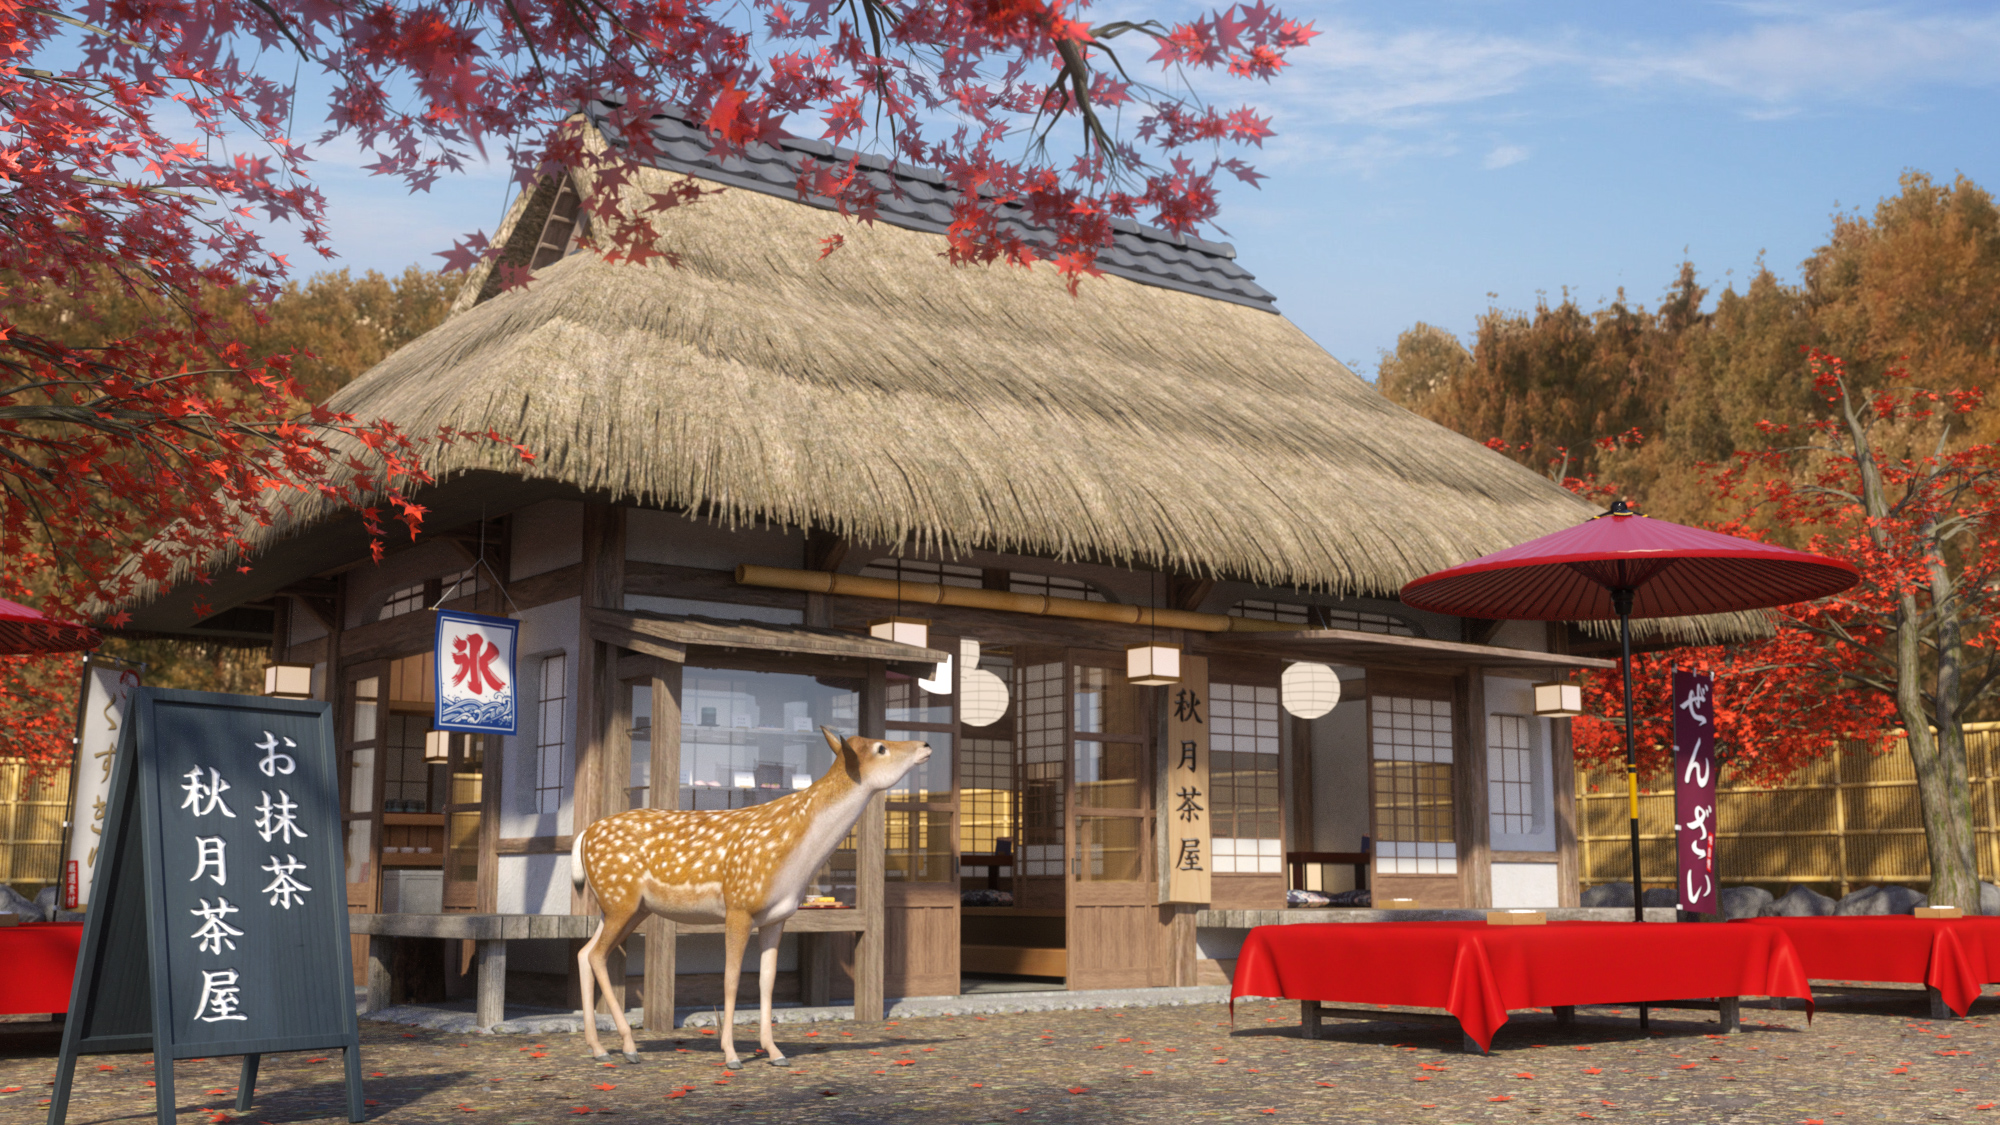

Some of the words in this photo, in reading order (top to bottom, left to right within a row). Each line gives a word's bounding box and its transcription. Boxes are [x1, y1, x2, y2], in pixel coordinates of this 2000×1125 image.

[451, 633, 506, 695] 氷
[254, 730, 312, 910] お抹茶
[1174, 687, 1204, 872] 秋月茶屋
[1679, 683, 1712, 904] ぜんざい
[180, 764, 248, 1024] 秋月茶屋
